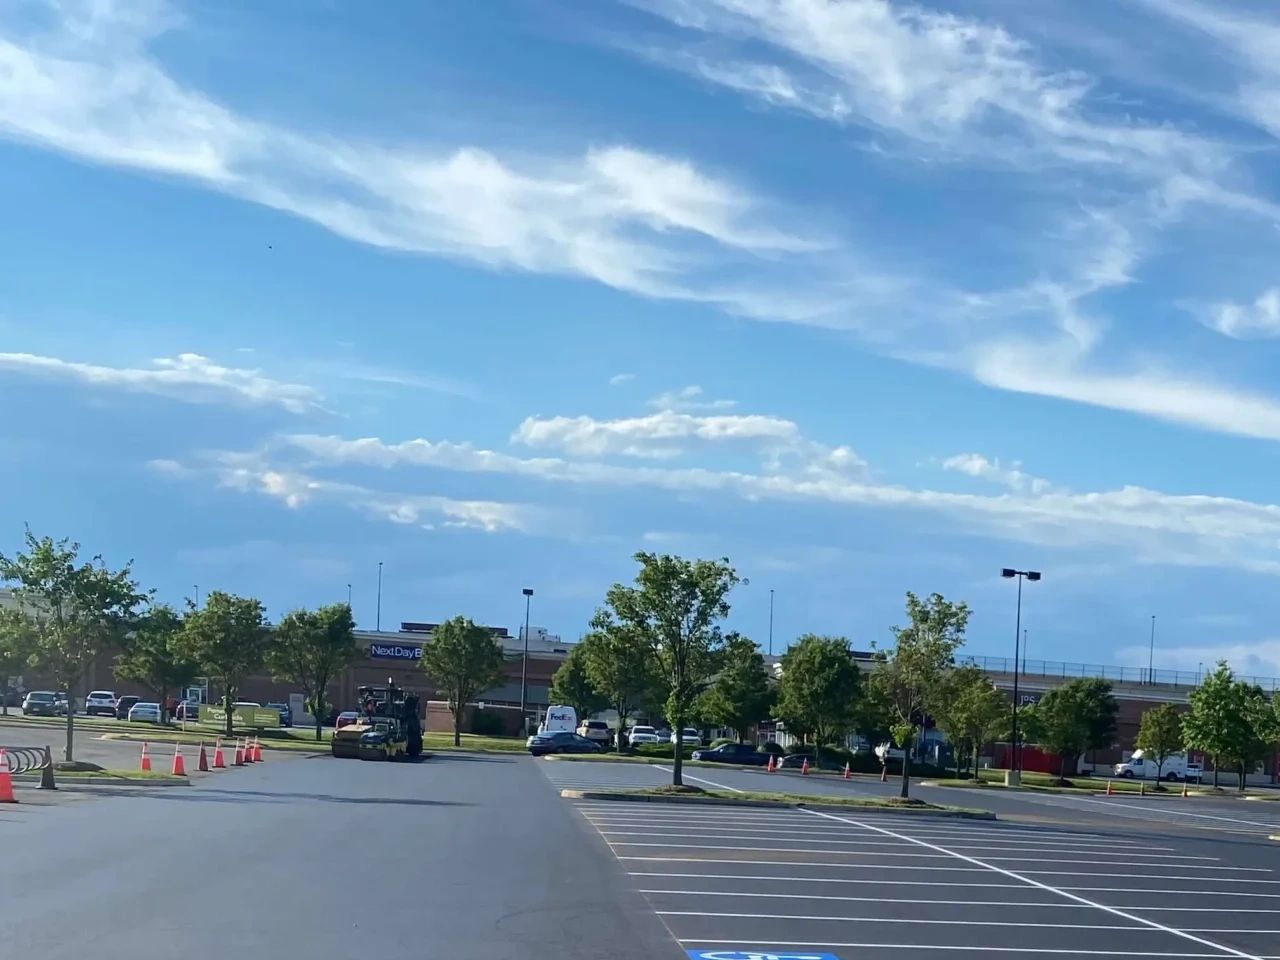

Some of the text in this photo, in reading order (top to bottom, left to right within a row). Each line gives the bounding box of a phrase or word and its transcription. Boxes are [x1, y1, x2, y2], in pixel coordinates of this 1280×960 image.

[372, 645, 394, 656] Next
[395, 647, 414, 659] Day
[550, 713, 572, 721] FedEx
